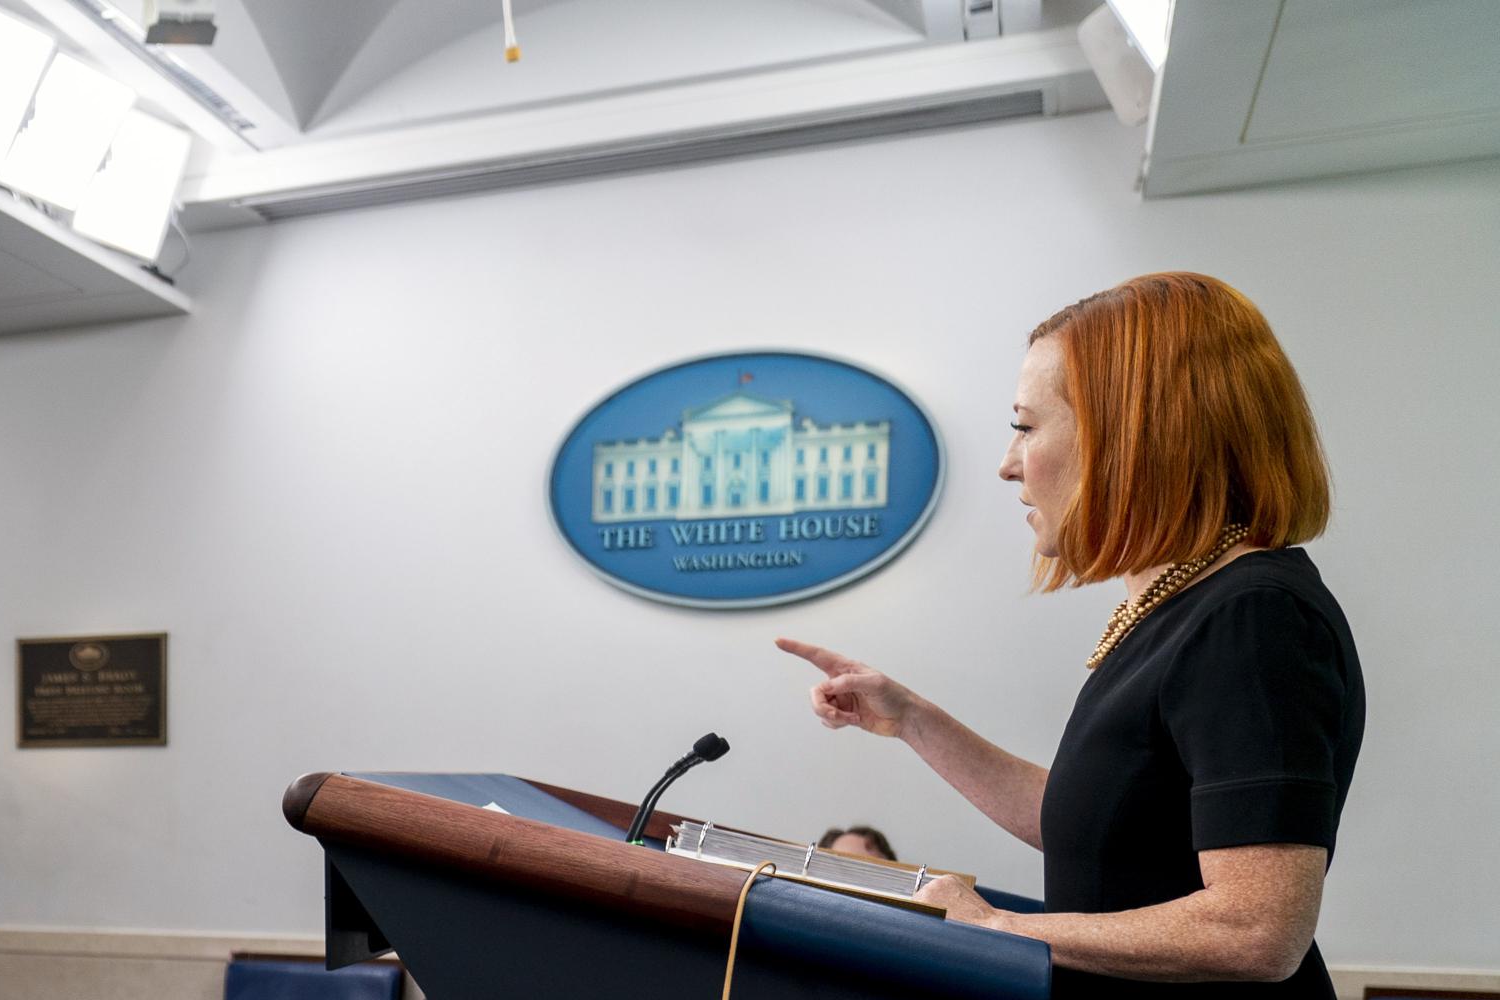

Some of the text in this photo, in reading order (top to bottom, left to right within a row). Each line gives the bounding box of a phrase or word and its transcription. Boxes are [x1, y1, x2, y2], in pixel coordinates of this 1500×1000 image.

[602, 513, 880, 549] THE WHITE HOUSE
[672, 550, 803, 573] WASHINGTON
